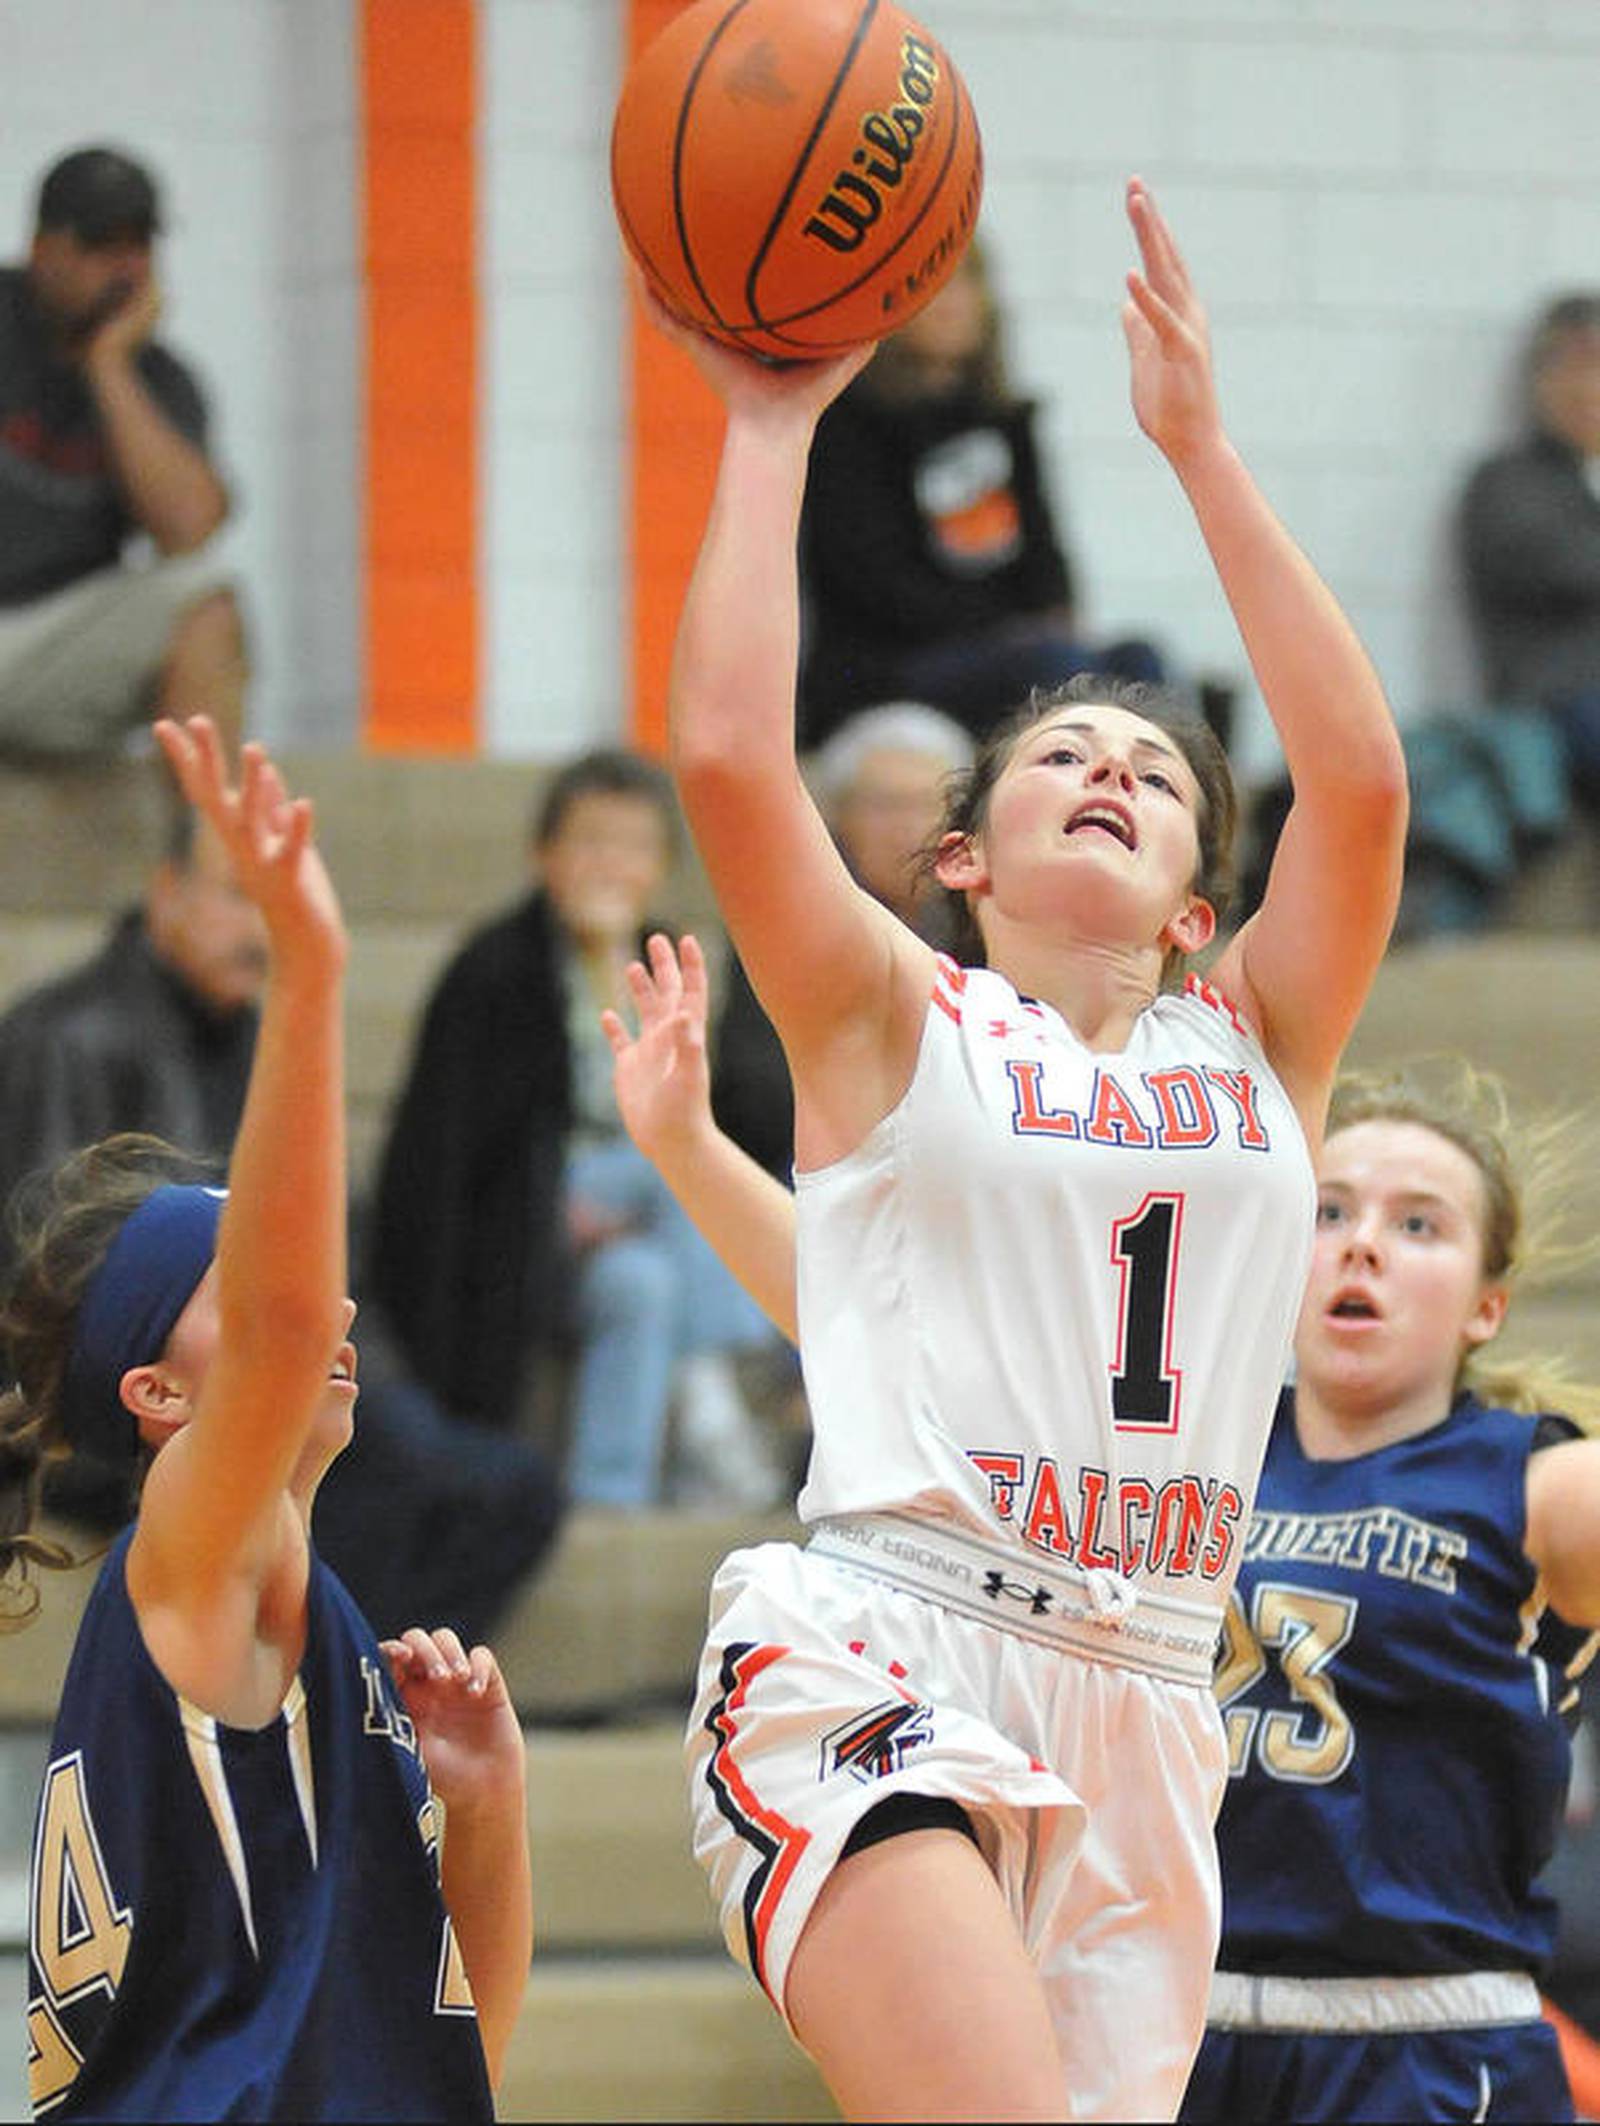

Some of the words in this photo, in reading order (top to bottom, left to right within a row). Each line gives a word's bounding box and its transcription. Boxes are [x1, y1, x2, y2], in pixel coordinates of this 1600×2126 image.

[803, 31, 938, 253] Wilson
[1006, 1061, 1270, 1152] LADY
[1109, 1191, 1184, 1434] 1
[882, 1535, 973, 1584] UNDER
[966, 1450, 1243, 1580] FALCONS
